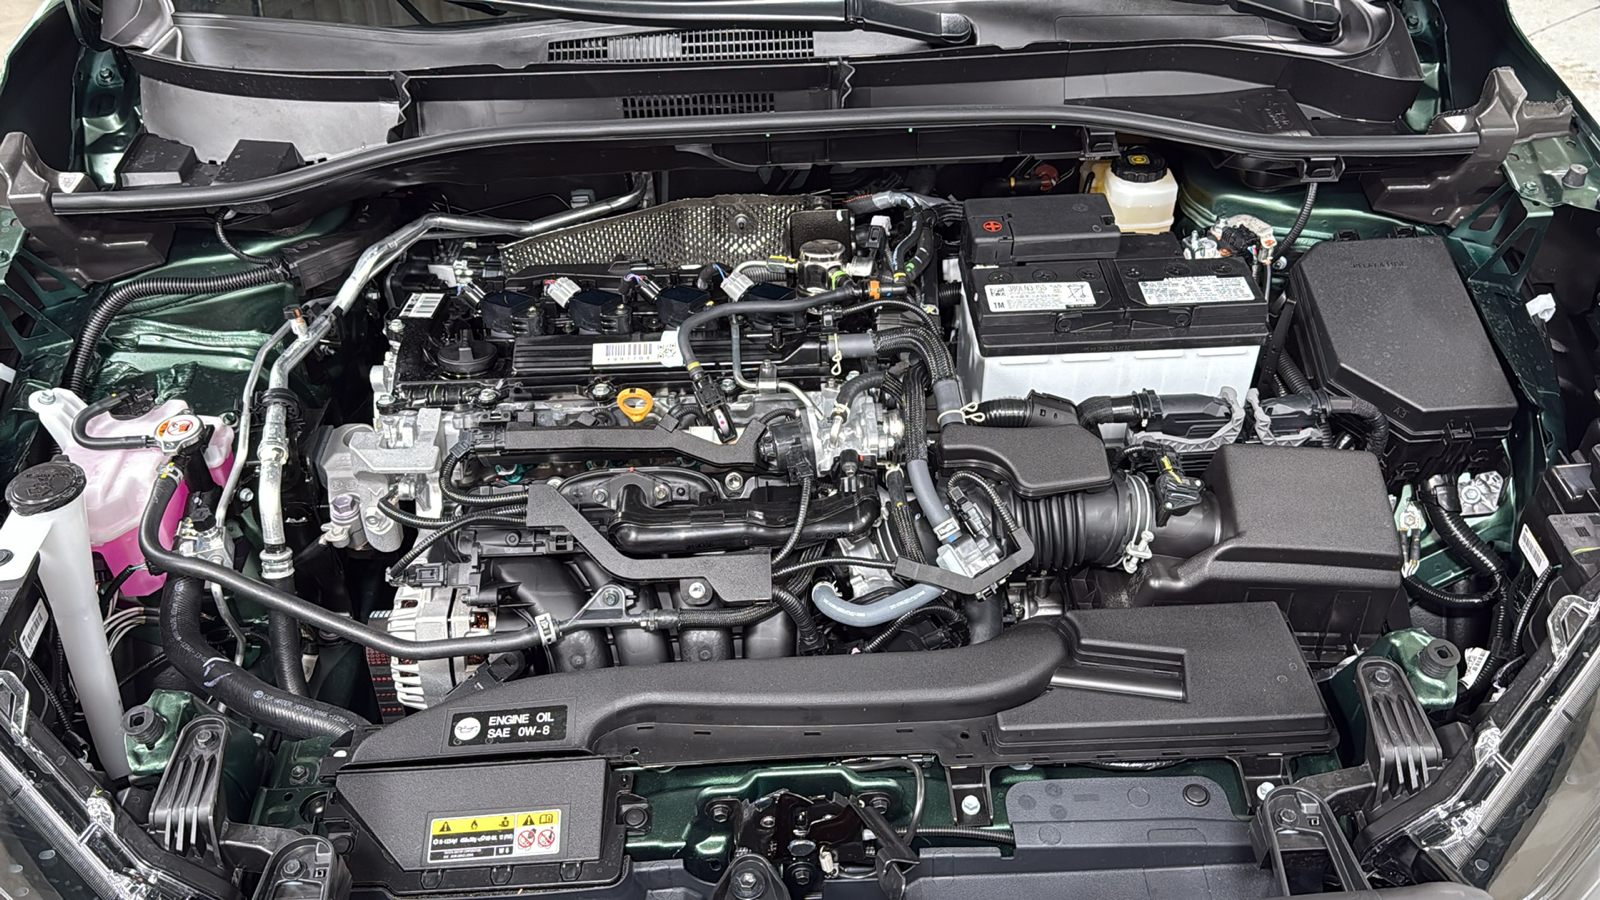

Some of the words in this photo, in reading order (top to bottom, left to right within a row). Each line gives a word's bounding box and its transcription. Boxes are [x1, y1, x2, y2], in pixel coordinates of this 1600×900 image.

[993, 301, 1005, 309] TM
[488, 713, 530, 726] ENGINE
[536, 712, 555, 723] OIL
[487, 727, 511, 739] SAE
[518, 725, 550, 737] 0W-8
